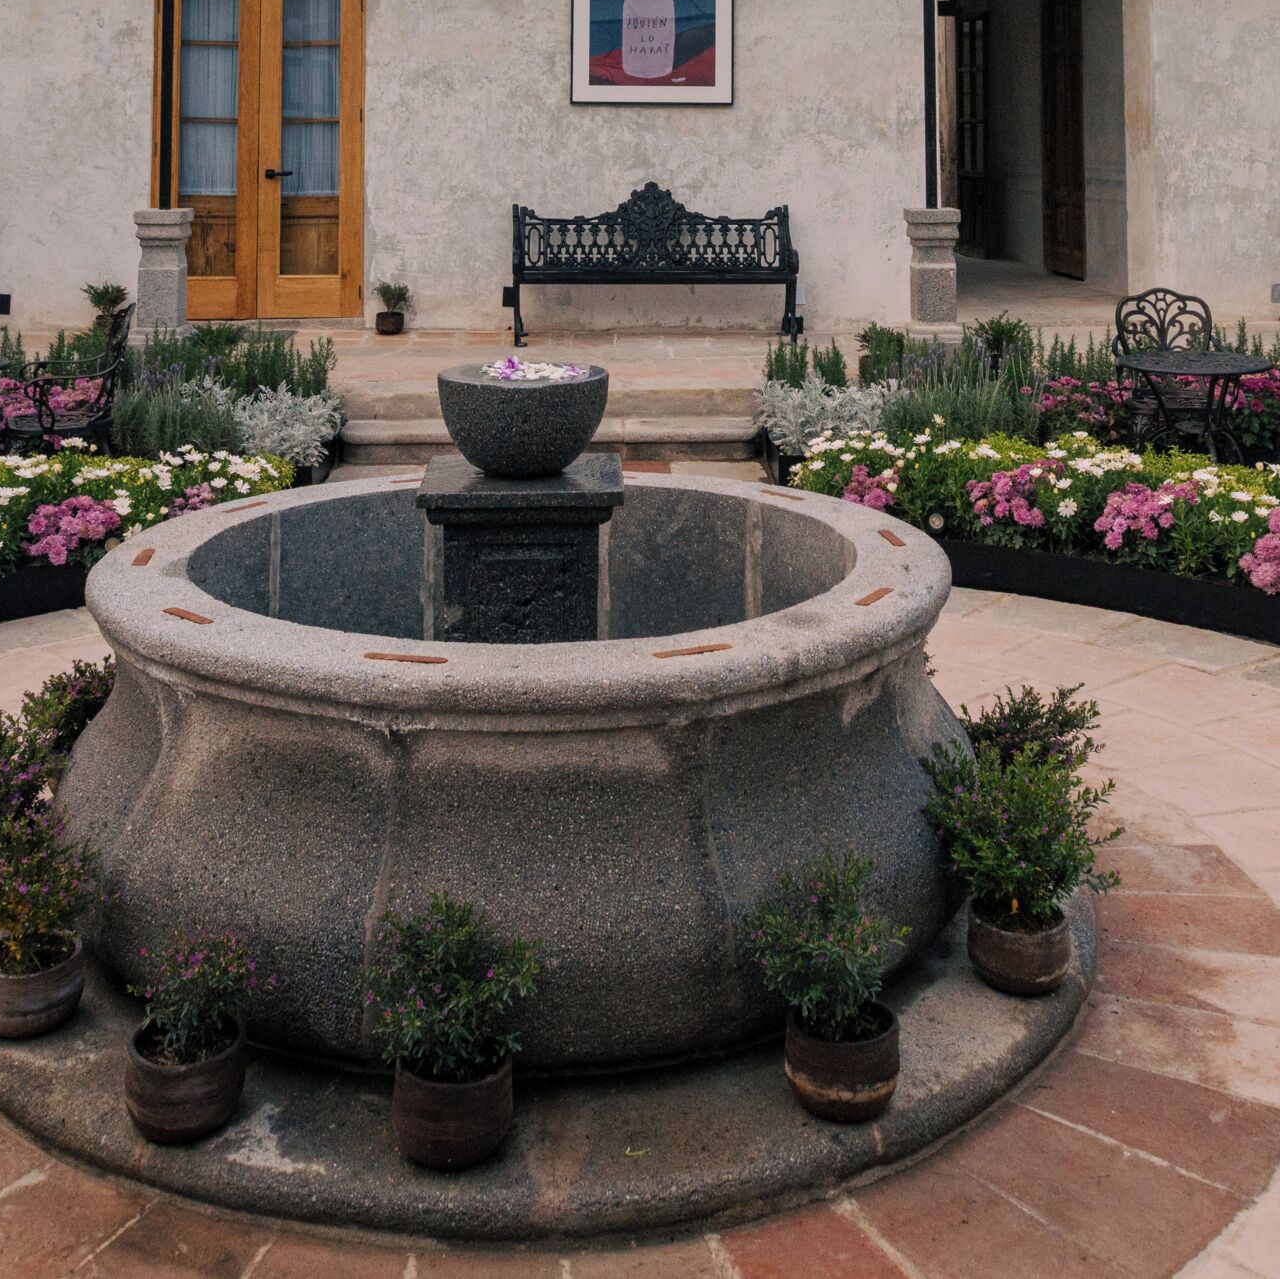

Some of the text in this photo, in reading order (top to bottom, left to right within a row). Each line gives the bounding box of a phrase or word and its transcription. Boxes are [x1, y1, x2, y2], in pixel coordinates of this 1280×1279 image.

[627, 16, 667, 30] ¿QUIÉN
[640, 35, 655, 43] LO
[630, 43, 669, 55] HARÁ?
